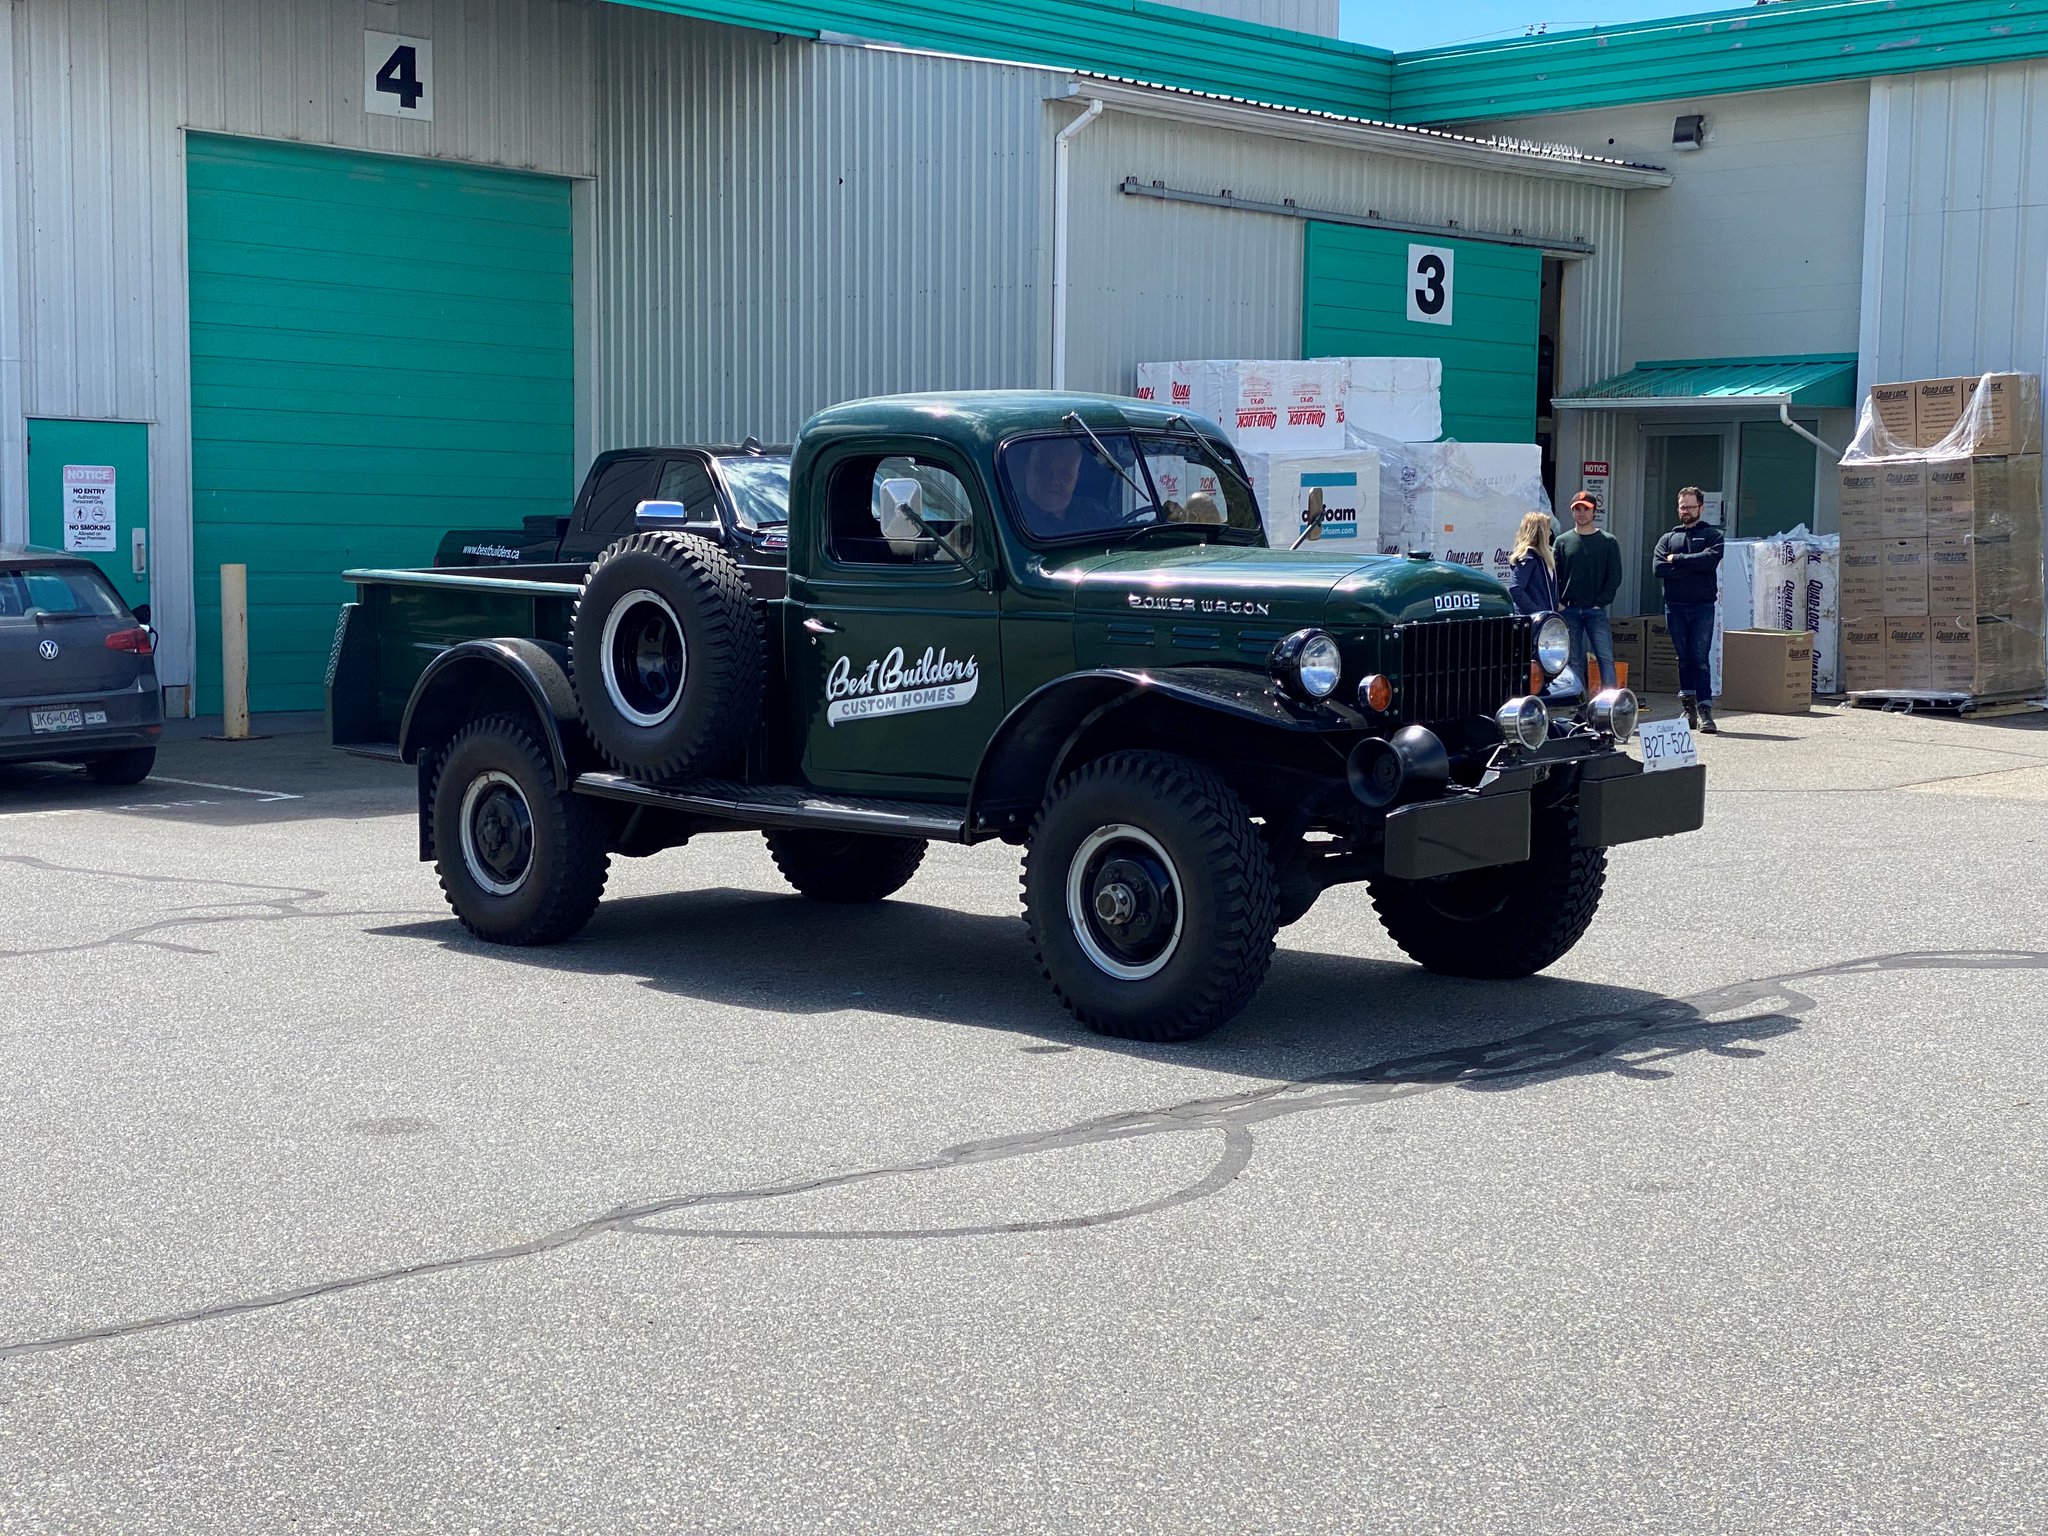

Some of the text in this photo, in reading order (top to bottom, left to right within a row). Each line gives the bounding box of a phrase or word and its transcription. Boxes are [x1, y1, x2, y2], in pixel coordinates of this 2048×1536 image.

[376, 45, 423, 110] 4
[1415, 254, 1445, 315] 3
[1876, 390, 1908, 400] QUAD-LOCK
[1922, 385, 1954, 395] QUAD-LOCK
[1237, 413, 1277, 430] QUAD-LOCK
[1288, 412, 1326, 428] QUAD-LOCK
[67, 470, 110, 480] NOTICE
[1585, 464, 1607, 473] NOTICE
[463, 544, 520, 559] www.bestbuilders.ca
[1128, 594, 1269, 616] POWER WAGON
[1434, 594, 1480, 610] DODGE
[1808, 579, 1823, 633] QUAD-LOCK
[1847, 632, 1879, 640] QUAD-LOCK
[1891, 630, 1924, 639] QUAD-LOCK
[1936, 631, 1970, 640] QUAD-LOCK
[826, 646, 977, 701] Best Builders
[842, 687, 956, 715] CUSTOM HOMES
[1644, 732, 1694, 759] B27-522
